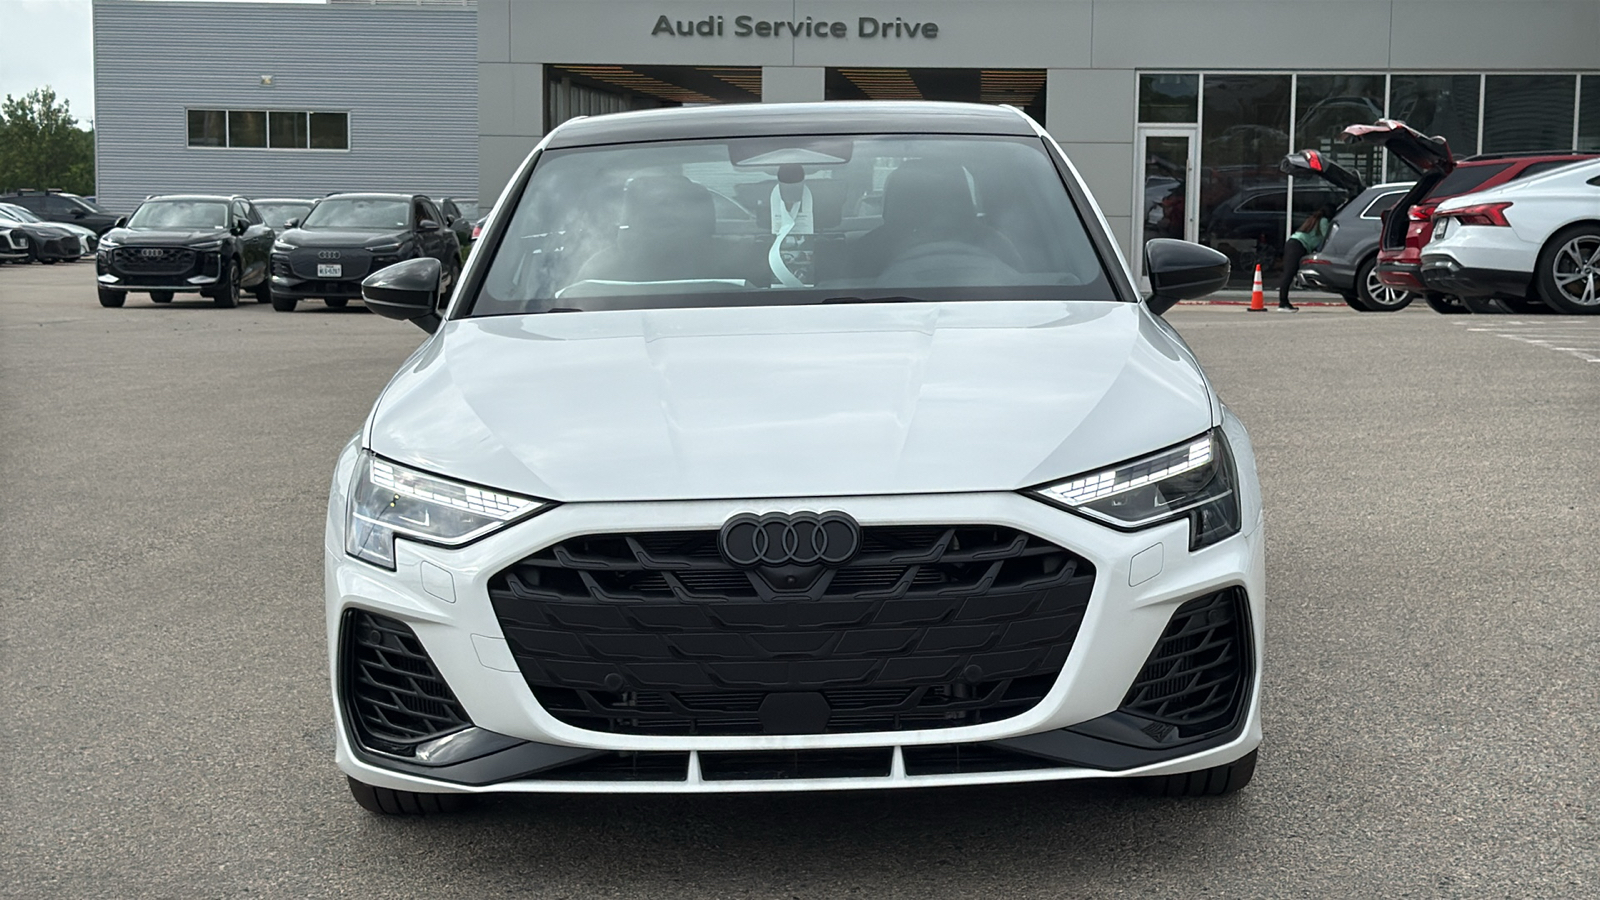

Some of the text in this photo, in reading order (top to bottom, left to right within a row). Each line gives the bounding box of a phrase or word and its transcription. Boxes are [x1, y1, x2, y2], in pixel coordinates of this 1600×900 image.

[651, 14, 939, 39] Audi Service Drive
